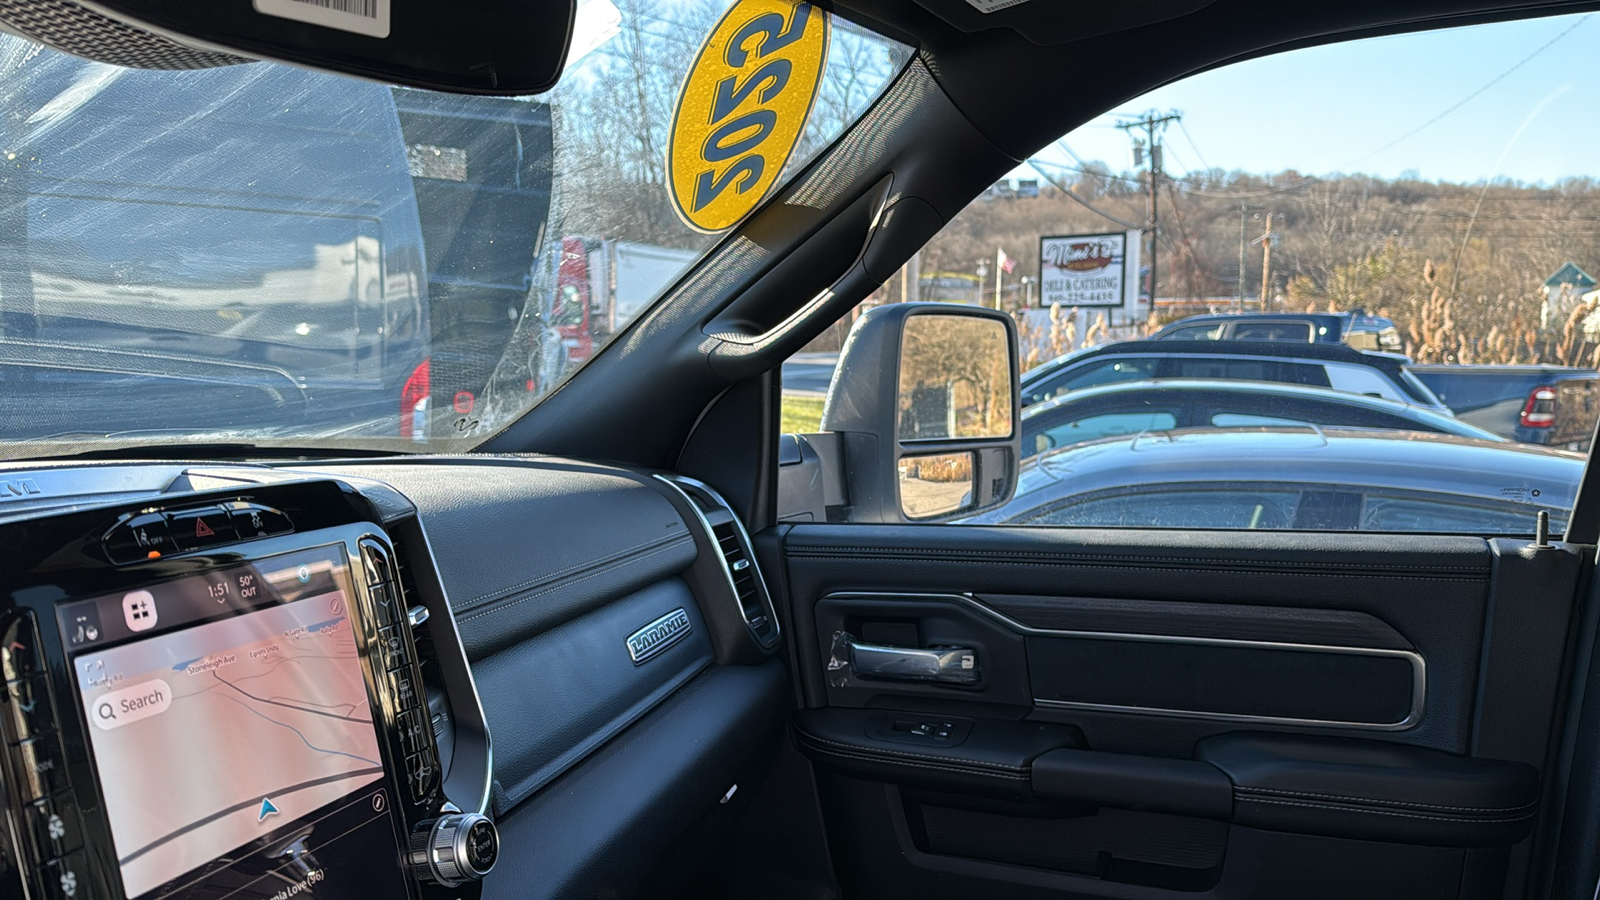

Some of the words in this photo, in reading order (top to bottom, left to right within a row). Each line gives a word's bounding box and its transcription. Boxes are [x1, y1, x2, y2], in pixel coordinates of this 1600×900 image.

[1044, 279, 1065, 292] DELI
[1073, 275, 1118, 291] CATERING
[151, 537, 163, 545] OFF
[208, 582, 230, 597] 1:51
[241, 587, 257, 598] OUT
[630, 613, 688, 655] LARAMIE
[187, 658, 223, 675] Stoneleigh
[223, 655, 235, 664] Ave
[120, 690, 164, 714] Search
[408, 725, 421, 737] A/C
[477, 839, 491, 852] ENTER
[287, 881, 307, 897] Love
